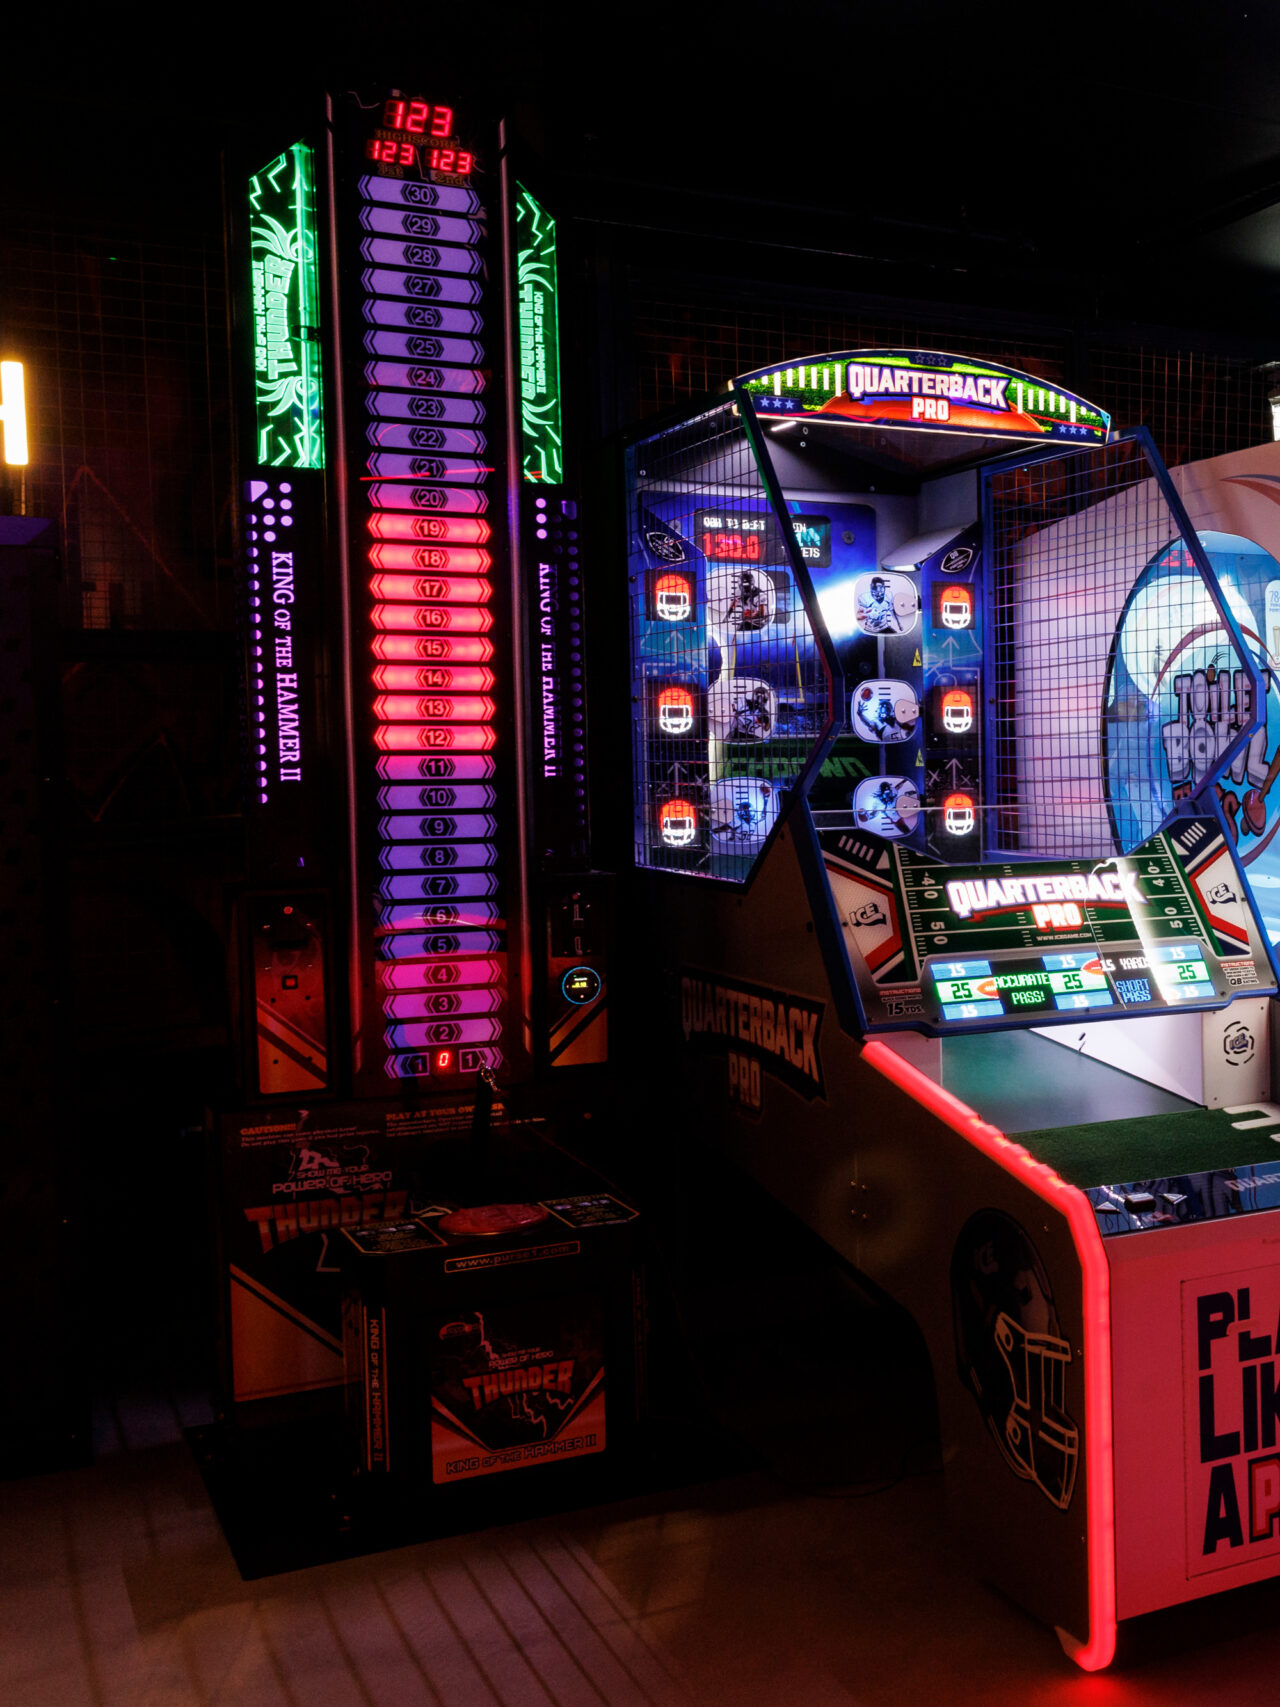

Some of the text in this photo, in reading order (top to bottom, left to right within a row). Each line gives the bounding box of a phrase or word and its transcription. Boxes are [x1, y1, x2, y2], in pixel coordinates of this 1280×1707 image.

[395, 101, 453, 137] 123
[373, 140, 415, 166] 123
[431, 149, 473, 174] 123
[410, 187, 430, 202] 30
[411, 218, 431, 233] 29
[412, 249, 433, 264] 28
[413, 279, 434, 295] 27
[533, 291, 545, 314] KING
[265, 254, 298, 380] THUNDER
[414, 309, 435, 325] 26
[415, 339, 436, 355] 25
[415, 370, 437, 386] 24
[848, 363, 1010, 408] QUARTERBACK
[416, 400, 438, 416] 23
[911, 397, 950, 421] PRO
[417, 430, 438, 446] 22
[419, 460, 439, 475] 21
[420, 491, 439, 506] 20
[421, 521, 440, 536] 19
[421, 551, 441, 566] 18
[422, 581, 441, 596] 17
[423, 611, 442, 626] 16
[424, 641, 443, 656] 15
[272, 551, 301, 781] KING OF THE HAMMER II
[425, 671, 444, 685] 14
[426, 701, 445, 715] 13
[427, 731, 445, 745] 12
[428, 761, 446, 775] 11
[429, 790, 447, 804] 10
[434, 820, 444, 834] 9
[434, 850, 445, 864] 8
[435, 880, 445, 894] 7
[1206, 882, 1238, 905] ICE
[946, 871, 1149, 919] QUARTERBACK
[436, 909, 446, 923] 6
[849, 902, 887, 927] ICE
[1031, 901, 1085, 930] PRO
[436, 939, 447, 952] 5
[1169, 947, 1186, 960] 15
[1060, 955, 1077, 968] 15
[1100, 959, 1117, 972] 15
[437, 968, 448, 982] 4
[949, 963, 966, 977] 15
[1177, 964, 1196, 980] 25
[993, 972, 1050, 989] ACCURATE
[1063, 972, 1082, 990] 25
[1115, 978, 1150, 993] SHORT
[1230, 977, 1242, 986] QB
[952, 982, 973, 1000] 25
[1012, 989, 1047, 1005] PASS!
[1121, 991, 1152, 1004] PASS
[1183, 985, 1200, 998] 15
[438, 998, 448, 1011] 3
[887, 1001, 905, 1017] 15
[1072, 995, 1090, 1008] 15
[960, 1004, 978, 1018] 15
[439, 1026, 449, 1040] 2
[681, 975, 820, 1084] QUARTERBACK
[439, 1052, 449, 1067] 0
[728, 1050, 762, 1109] PRO
[297, 1169, 326, 1180] SHOW
[272, 1177, 327, 1195] POWER
[352, 1170, 393, 1187] HERO
[243, 1189, 409, 1255] THUNDER
[369, 1318, 381, 1350] KING
[371, 1368, 380, 1389] THE
[462, 1359, 576, 1411] THUNDER
[372, 1392, 383, 1450] HAMMER
[446, 1434, 597, 1474] KING OF THE HAMMER II
[1202, 1462, 1245, 1555] A
